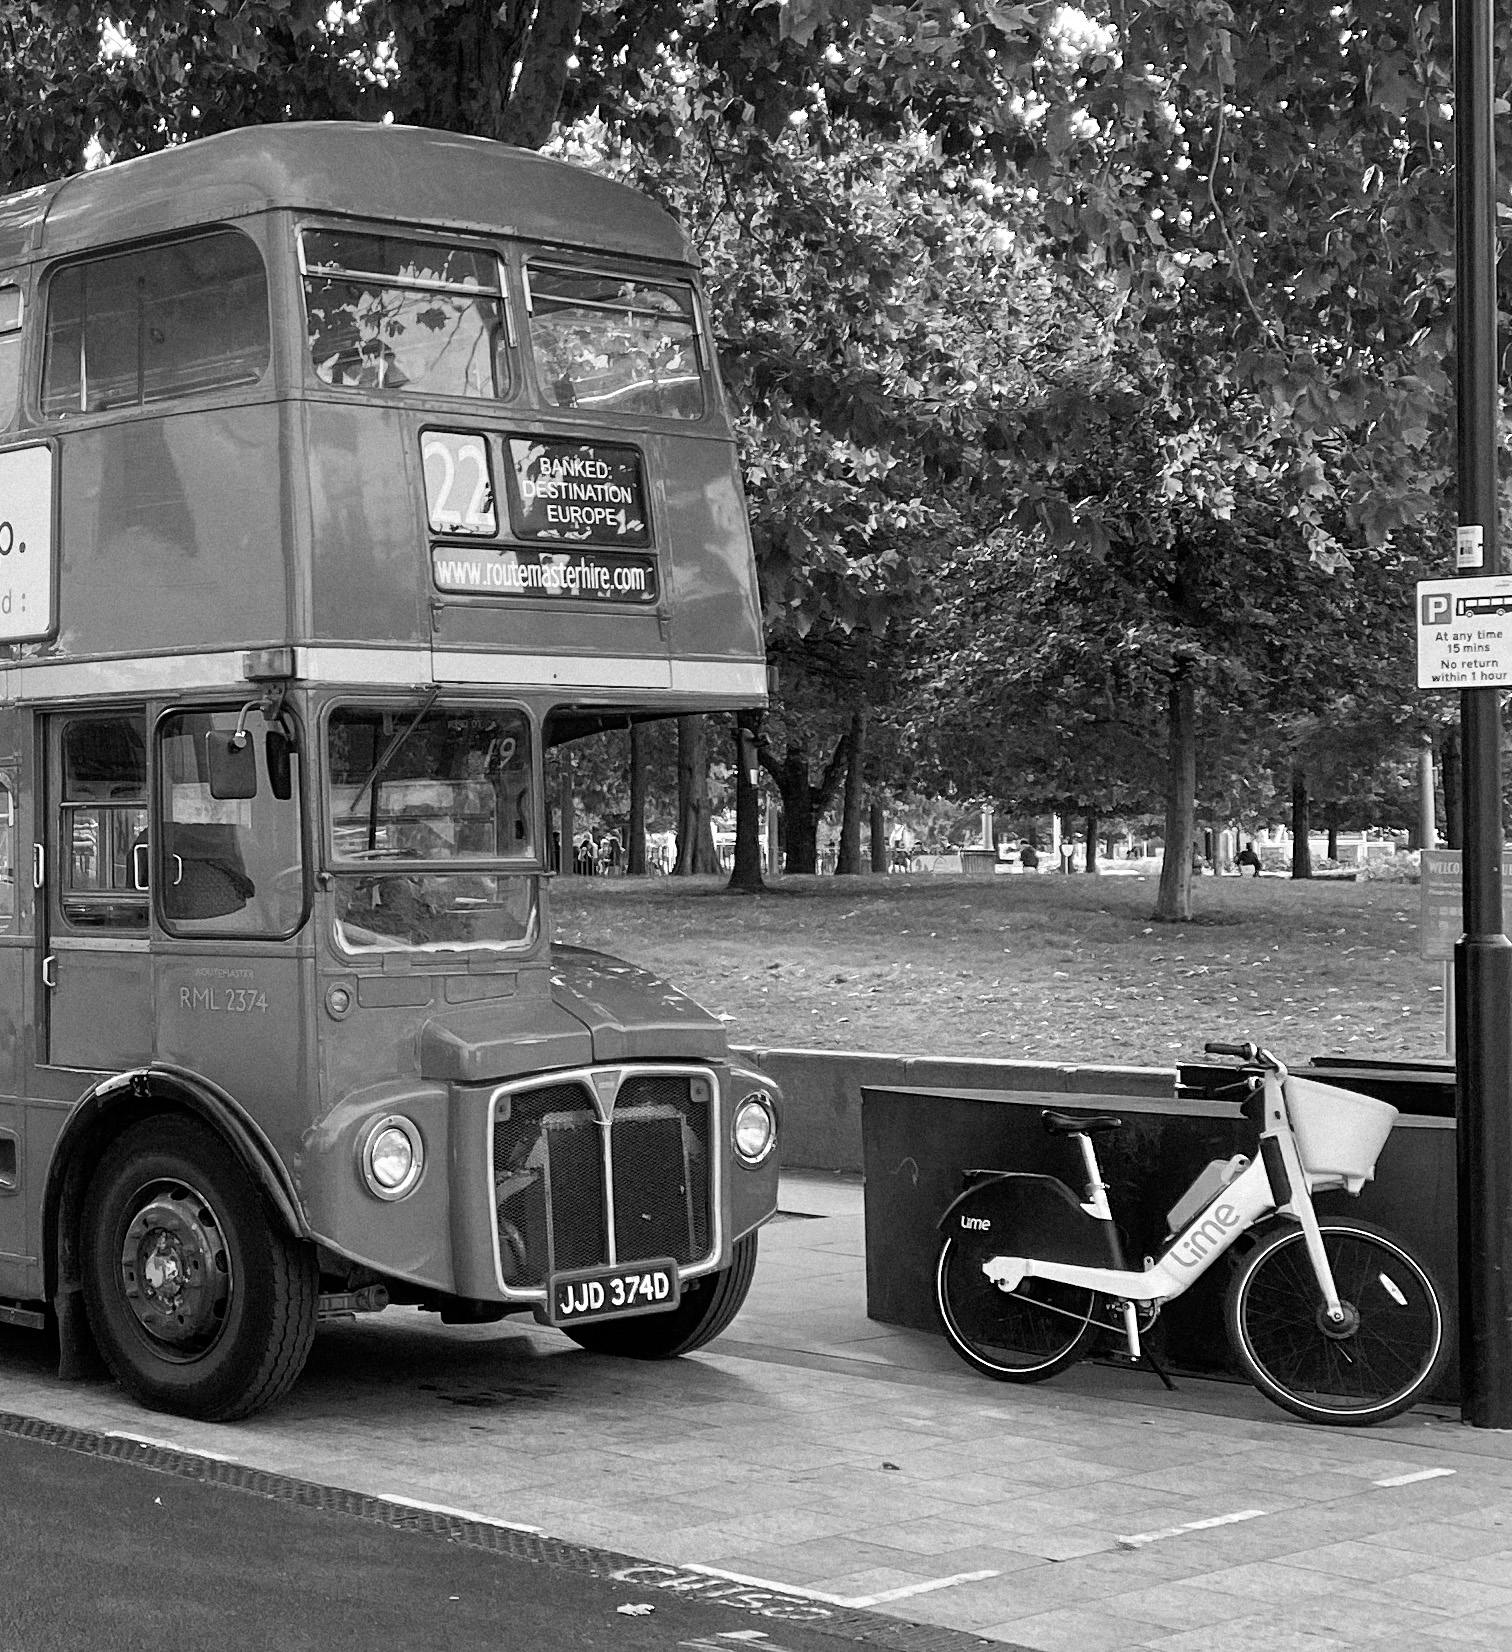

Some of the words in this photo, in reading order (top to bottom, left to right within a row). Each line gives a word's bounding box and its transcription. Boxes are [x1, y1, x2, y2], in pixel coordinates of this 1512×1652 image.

[540, 457, 613, 479] BANKED:
[424, 441, 496, 525] 22
[523, 480, 632, 504] DESTINATION
[547, 504, 617, 525] EUROPE
[437, 557, 645, 590] www.routemasterhire.com
[1429, 596, 1448, 623] P
[1435, 631, 1448, 641] At
[1453, 633, 1472, 642] any
[1477, 630, 1503, 640] time
[1448, 643, 1460, 653] 15
[1463, 643, 1490, 653] mins
[1441, 660, 1457, 669] No
[1461, 660, 1499, 668] return
[1432, 672, 1467, 682] within
[1472, 672, 1476, 680] 1
[1481, 671, 1507, 680] hour
[1429, 862, 1462, 875] WELCO
[179, 987, 220, 1010] RML
[226, 988, 268, 1012] 2374
[1170, 1203, 1240, 1268] Lime
[560, 1281, 605, 1314] JJD
[610, 1272, 669, 1306] 374D
